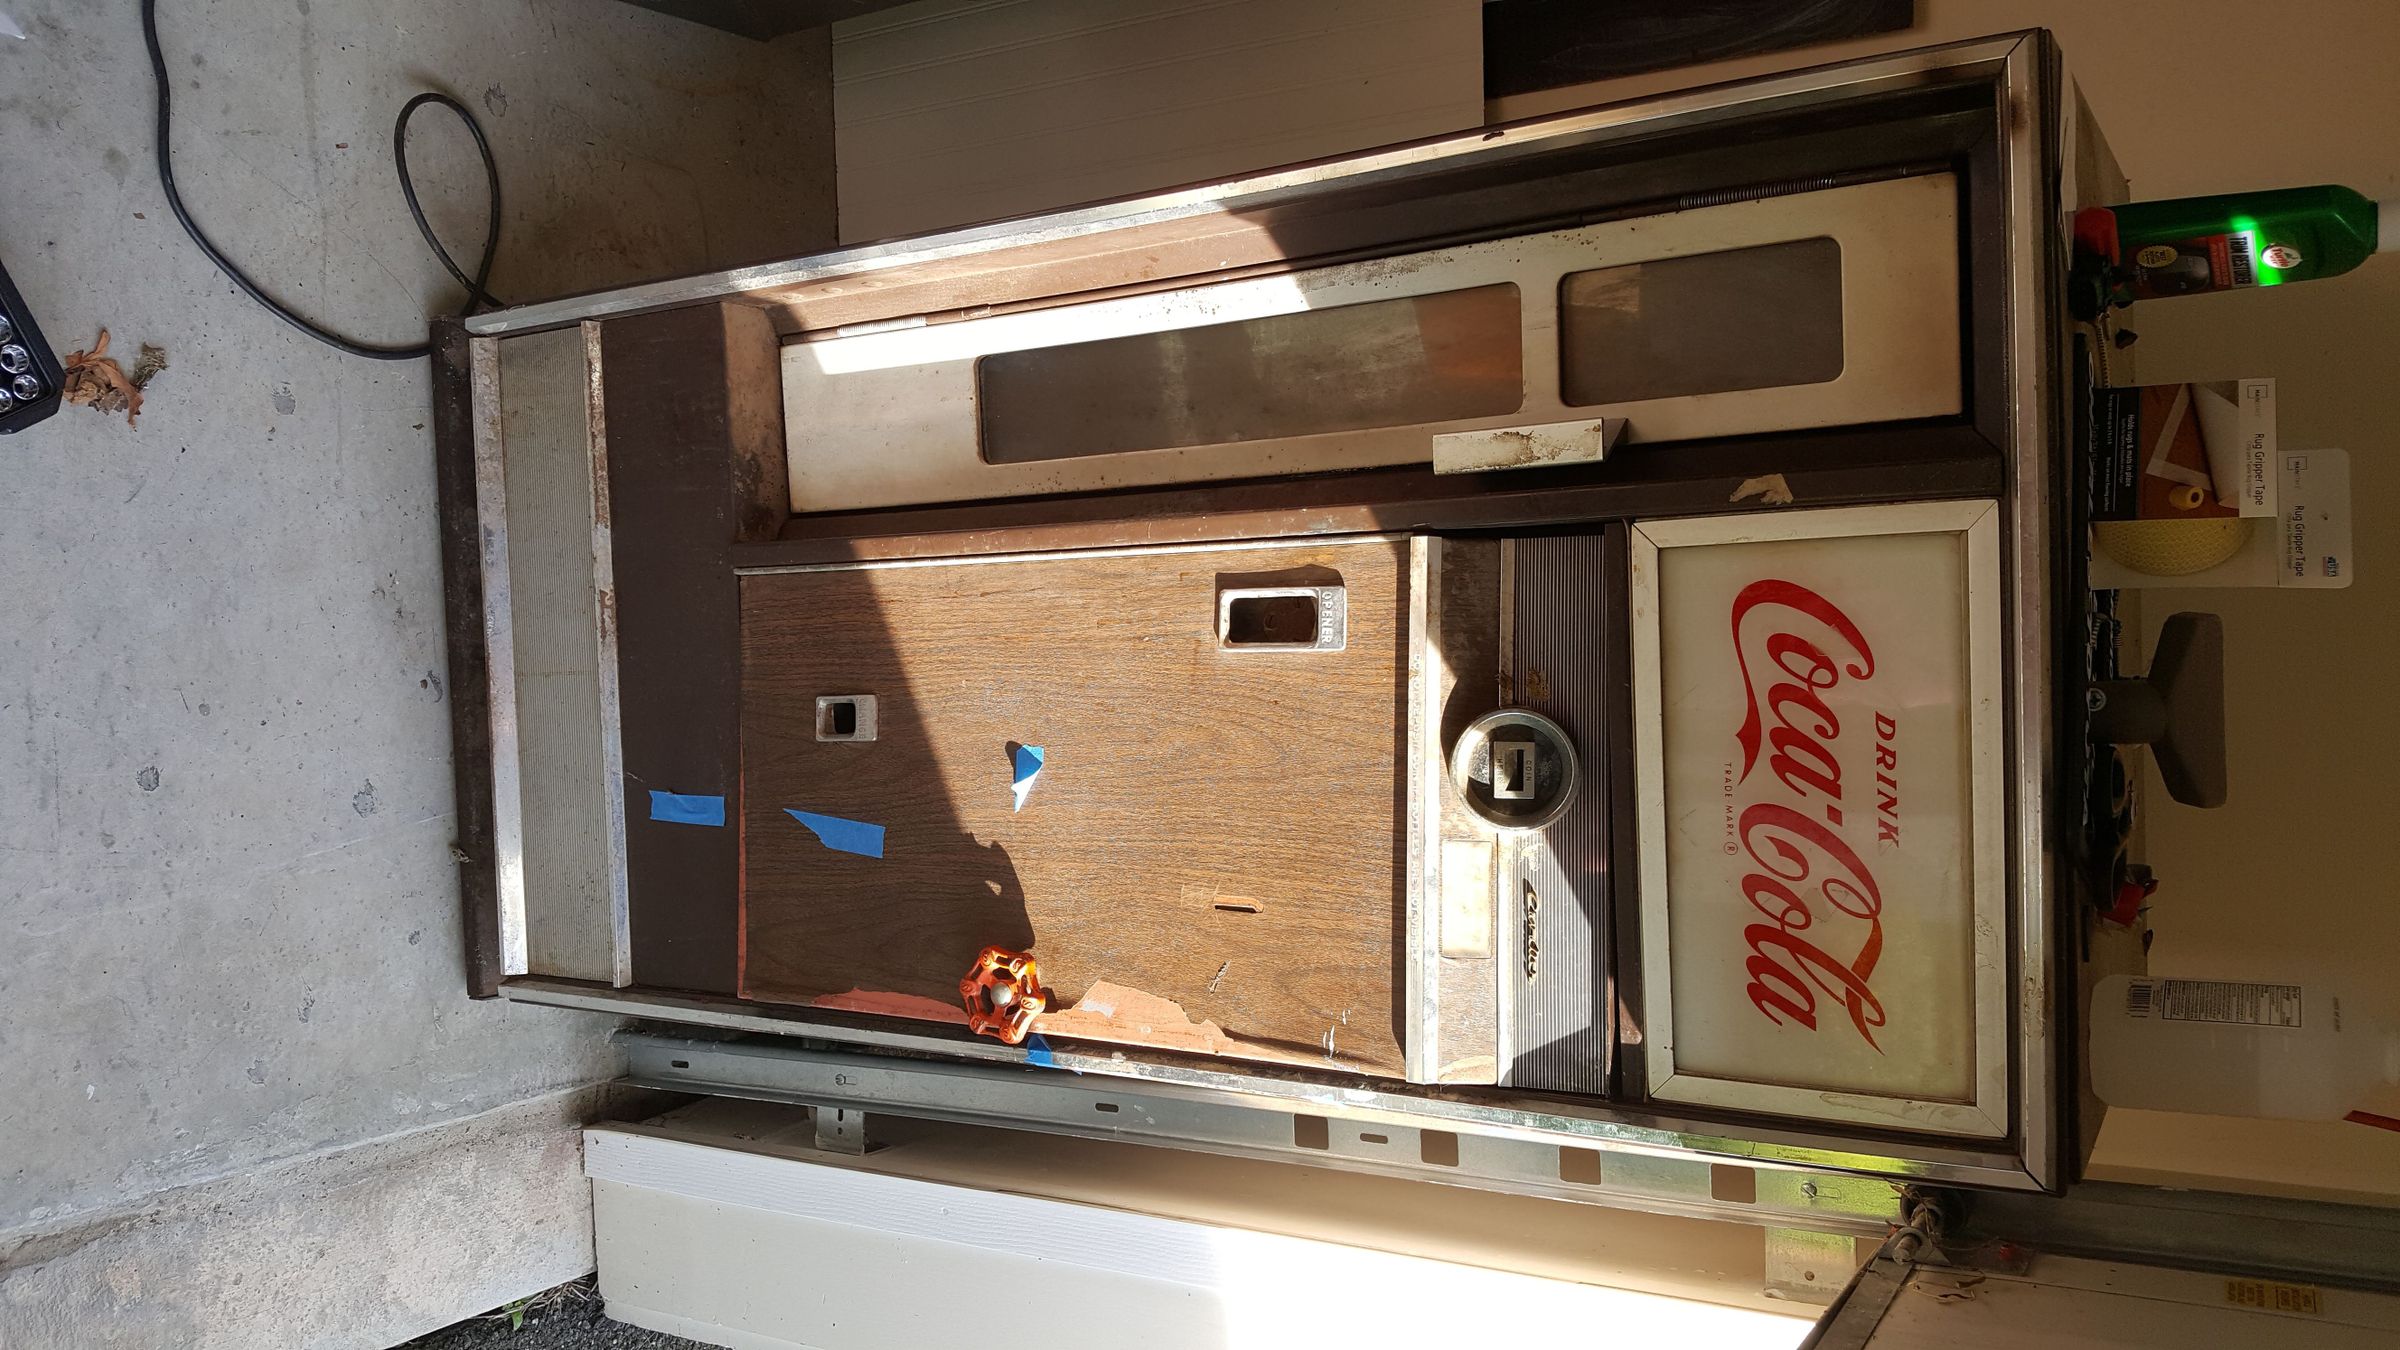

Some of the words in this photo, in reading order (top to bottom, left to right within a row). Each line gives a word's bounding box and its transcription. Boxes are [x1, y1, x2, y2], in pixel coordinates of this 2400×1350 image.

[2229, 237, 2249, 254] TRIM
[2231, 255, 2252, 285] RESTORER
[2127, 414, 2135, 429] Holds
[2252, 433, 2265, 449] Rug
[2253, 451, 2266, 483] Gripper
[2253, 485, 2266, 506] Tape
[2293, 505, 2305, 521] Rug
[2293, 523, 2306, 554] Gripper
[2294, 556, 2306, 577] Tape
[1321, 591, 1334, 644] OPENER
[858, 698, 867, 739] CHANGE
[1525, 760, 1533, 782] COIN
[1724, 762, 1733, 798] TRADE
[1875, 711, 1900, 848] DRINK
[1725, 805, 1734, 838] MARK
[1732, 580, 1886, 1055] Coca-Cola
